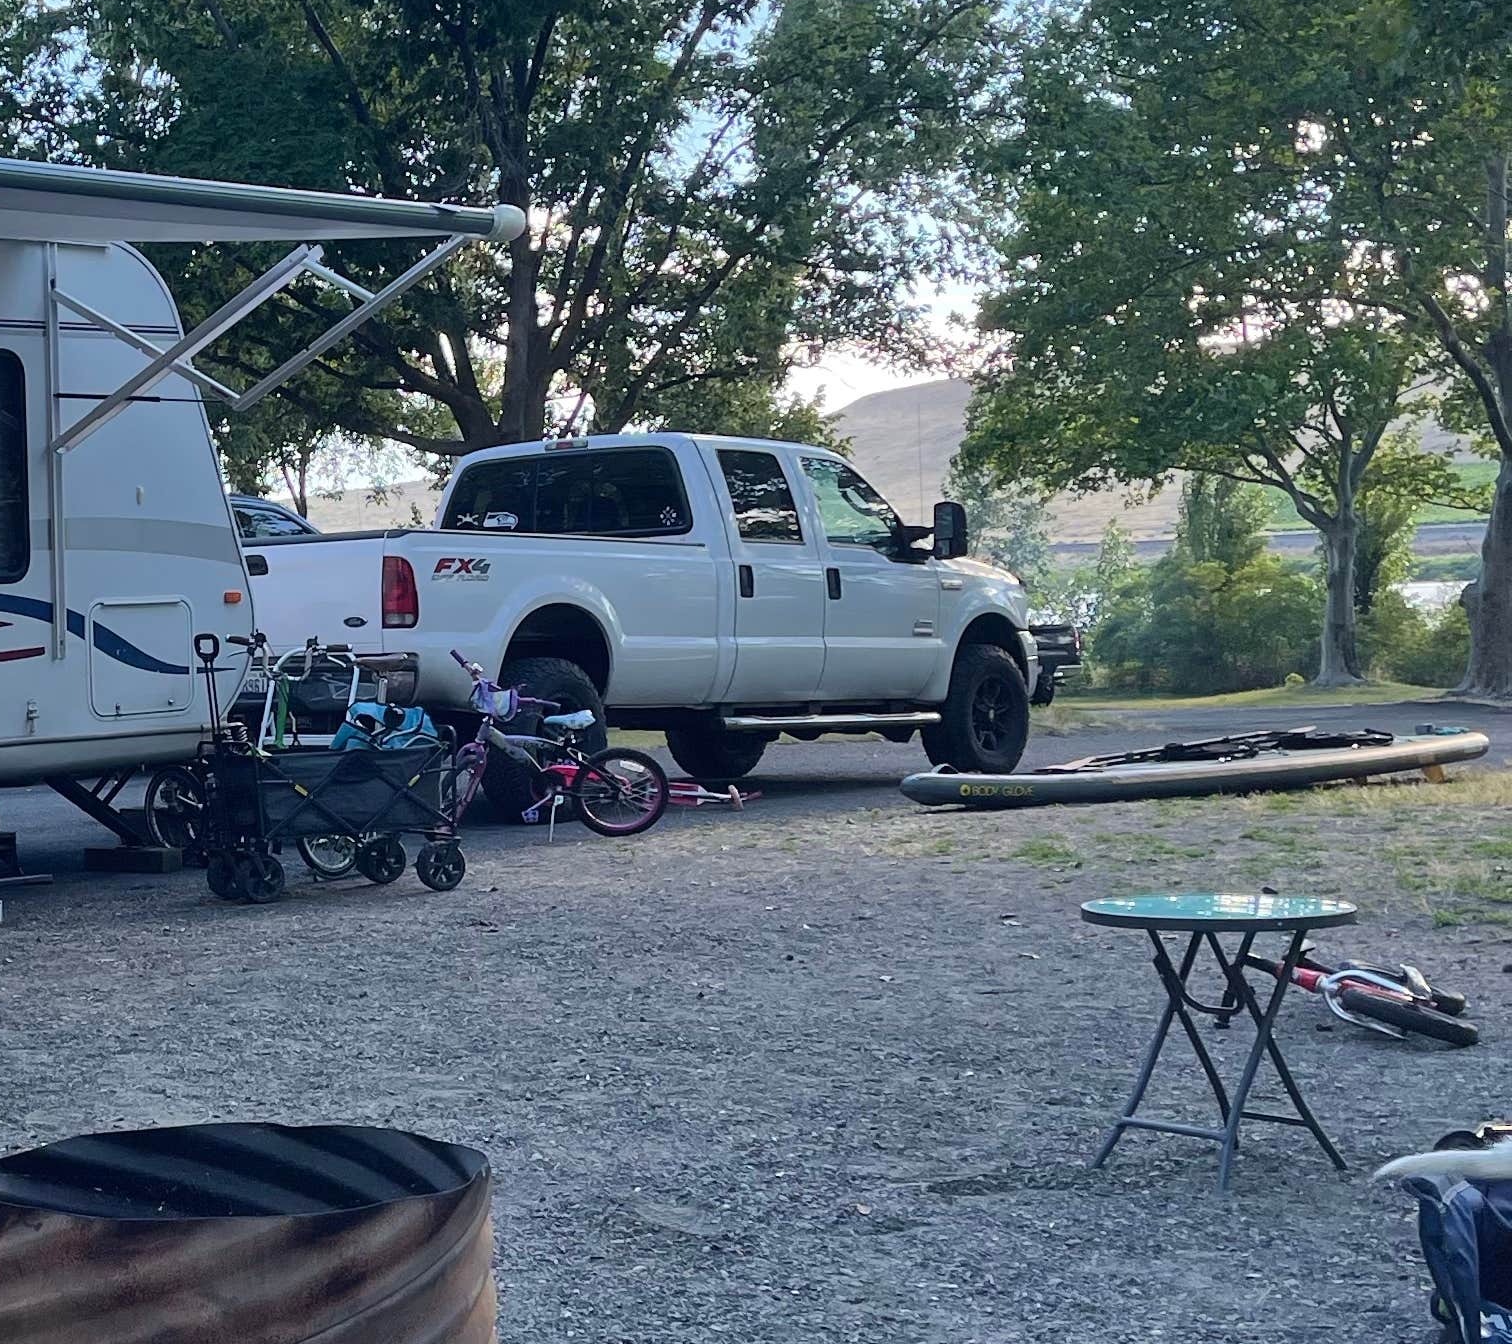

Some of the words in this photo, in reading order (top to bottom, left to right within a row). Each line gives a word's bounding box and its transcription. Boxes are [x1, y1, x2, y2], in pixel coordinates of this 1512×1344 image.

[433, 557, 492, 575] FX4
[971, 784, 1000, 796] BODY
[1001, 784, 1034, 797] GLOVE
